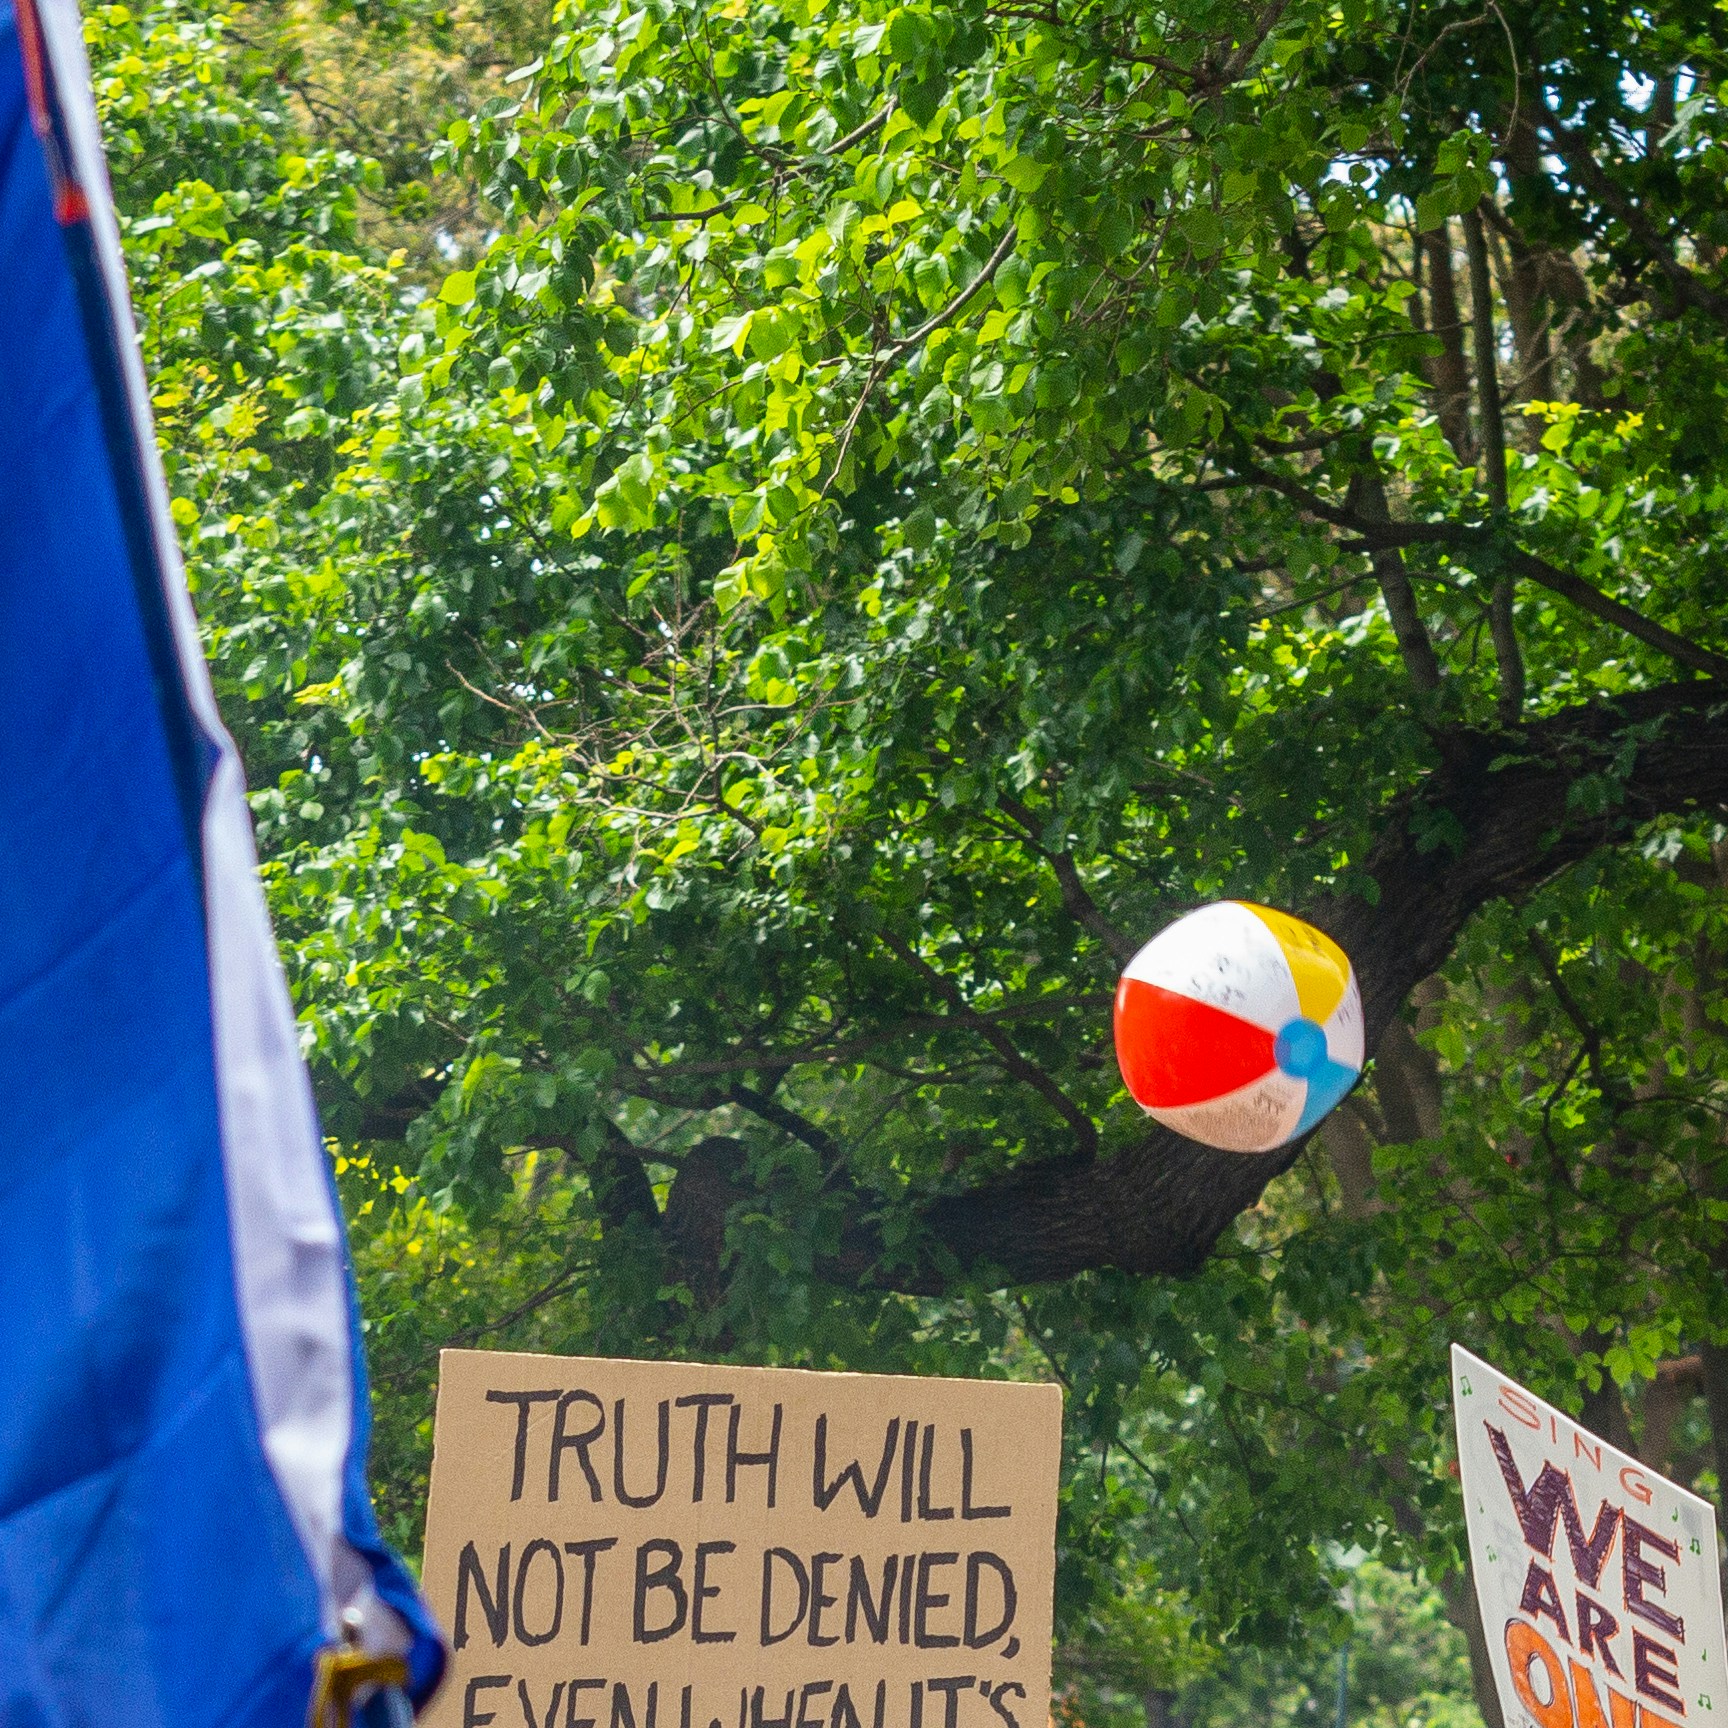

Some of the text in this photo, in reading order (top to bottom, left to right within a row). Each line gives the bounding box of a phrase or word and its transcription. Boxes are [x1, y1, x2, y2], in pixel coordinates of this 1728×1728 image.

[486, 1390, 1010, 1522] TRUTH WILL
[1498, 1384, 1653, 1507] SING
[453, 1538, 1019, 1658] NOT BE DENIED,
[1483, 1419, 1686, 1645] WE
[1519, 1557, 1687, 1717] ARE
